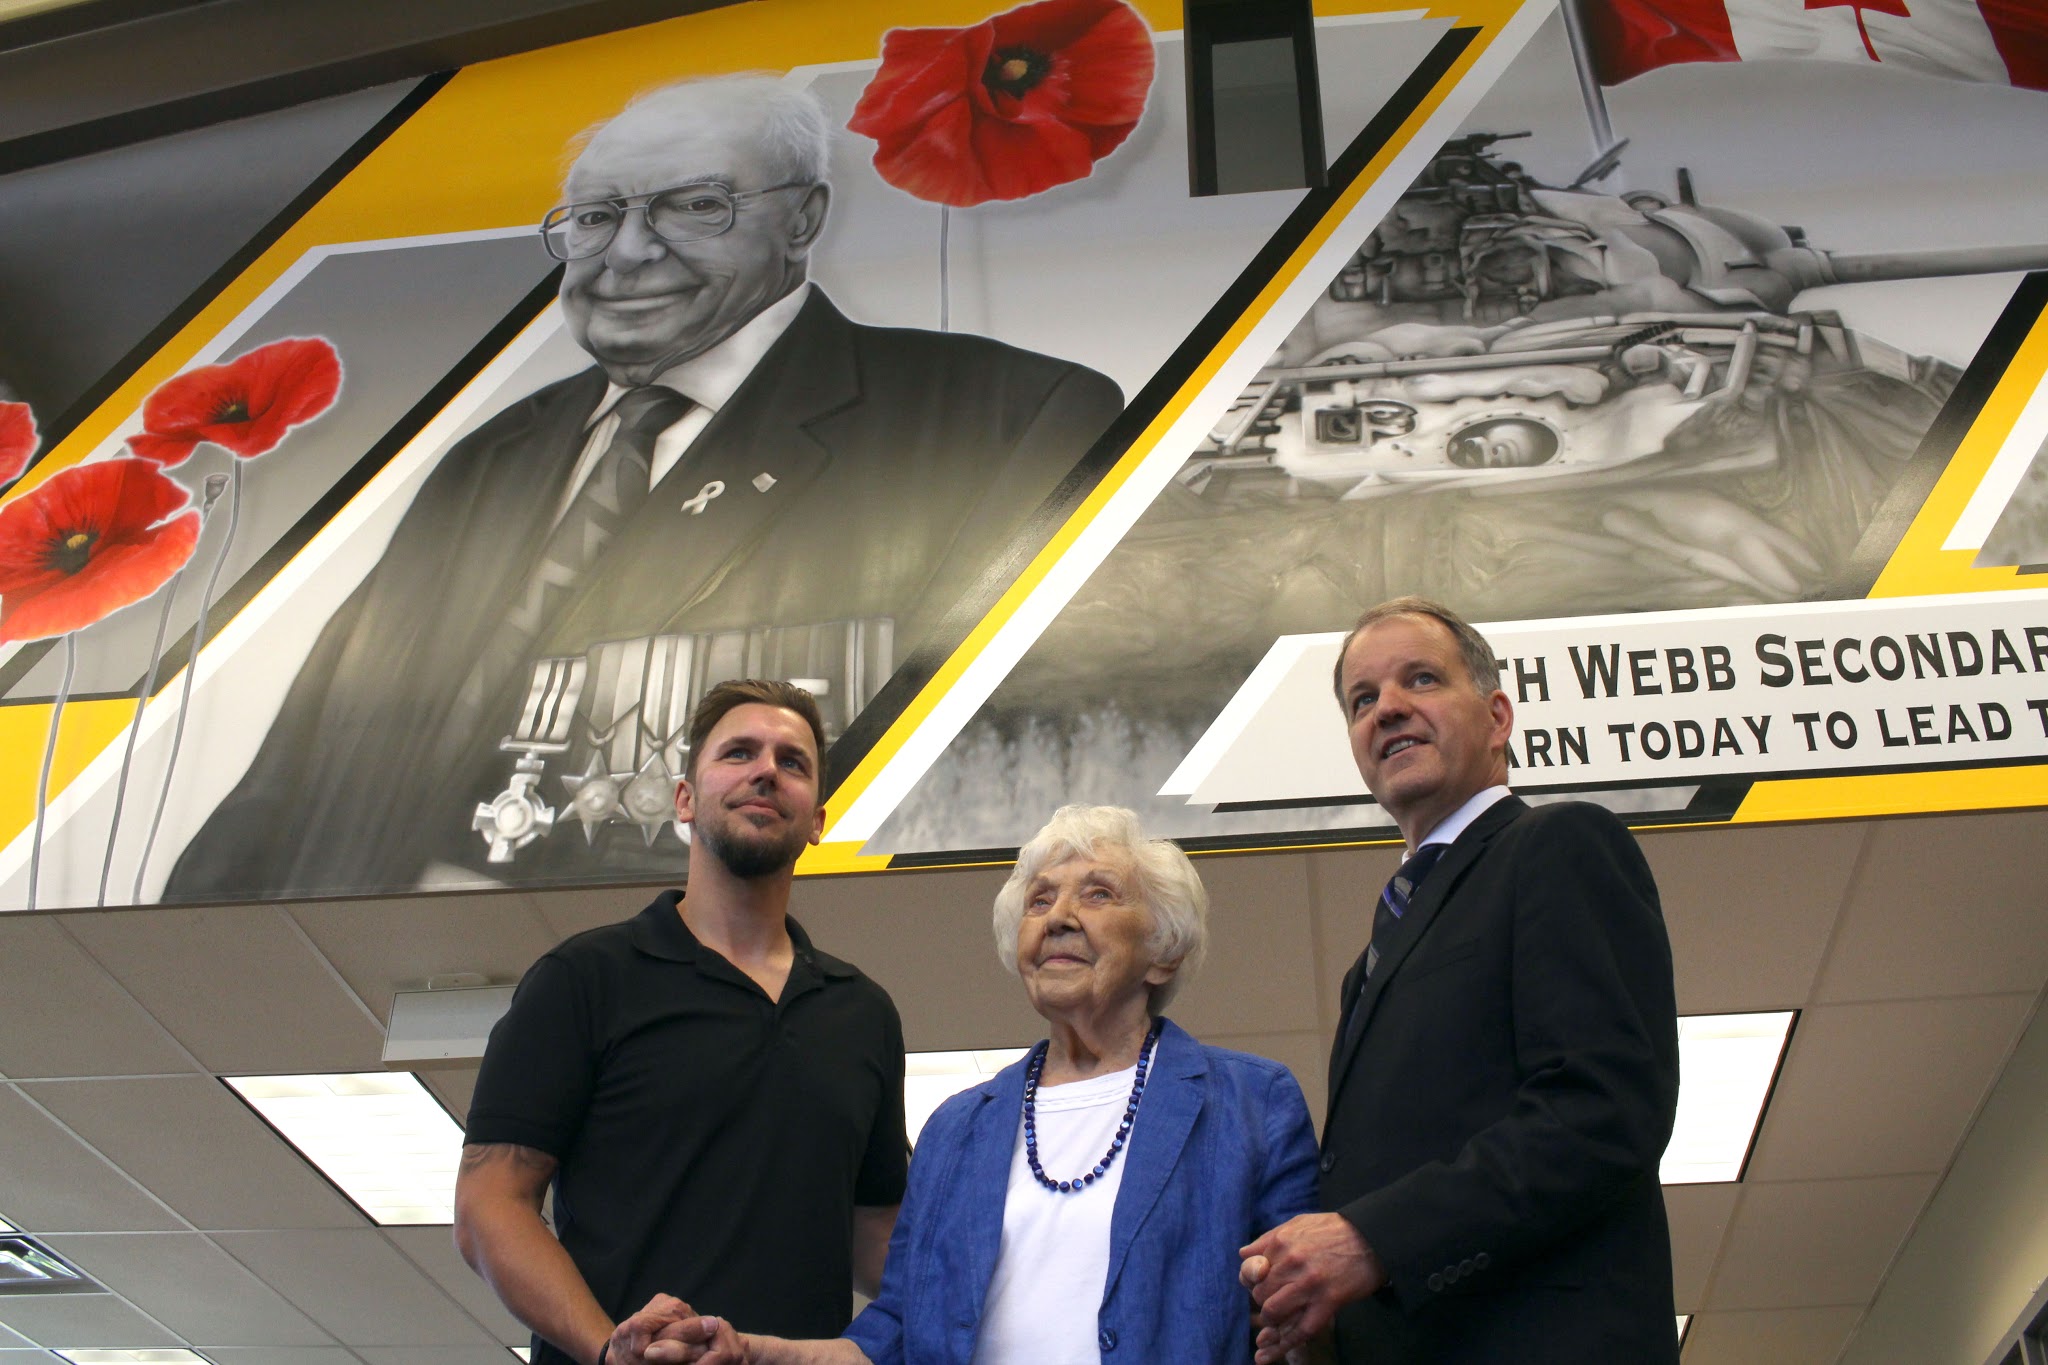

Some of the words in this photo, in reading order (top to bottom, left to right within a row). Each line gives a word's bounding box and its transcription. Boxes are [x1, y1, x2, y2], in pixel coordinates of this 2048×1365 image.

[1496, 657, 1551, 703] H
[1567, 643, 1736, 699] WEBB
[1607, 715, 1772, 762] TODAY
[1792, 710, 1858, 752] TO
[1875, 701, 2012, 748] LEAD
